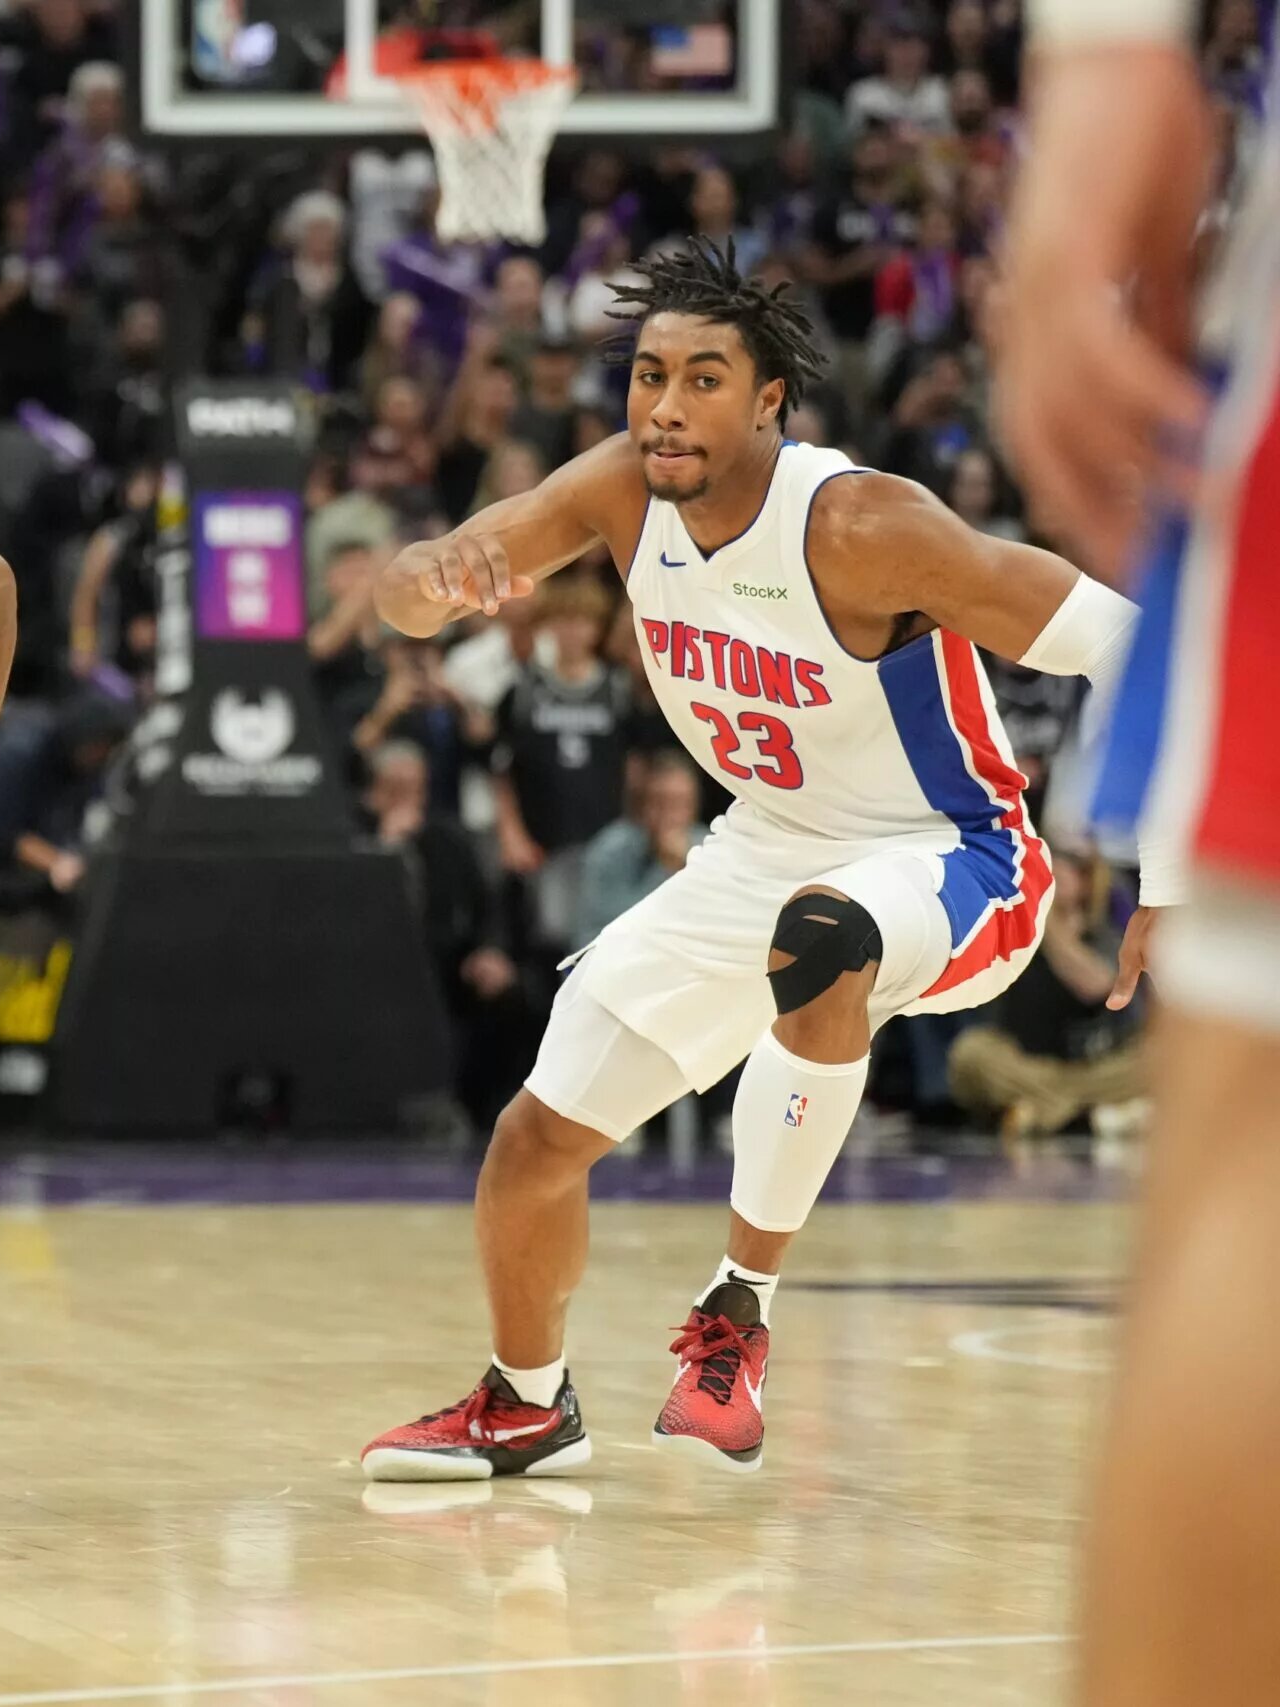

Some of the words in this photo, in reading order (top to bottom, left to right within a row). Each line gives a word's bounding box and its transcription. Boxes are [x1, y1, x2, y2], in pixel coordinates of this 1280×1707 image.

[733, 583, 788, 600] StockX
[640, 616, 833, 709] PISTONS
[690, 701, 804, 791] 23
